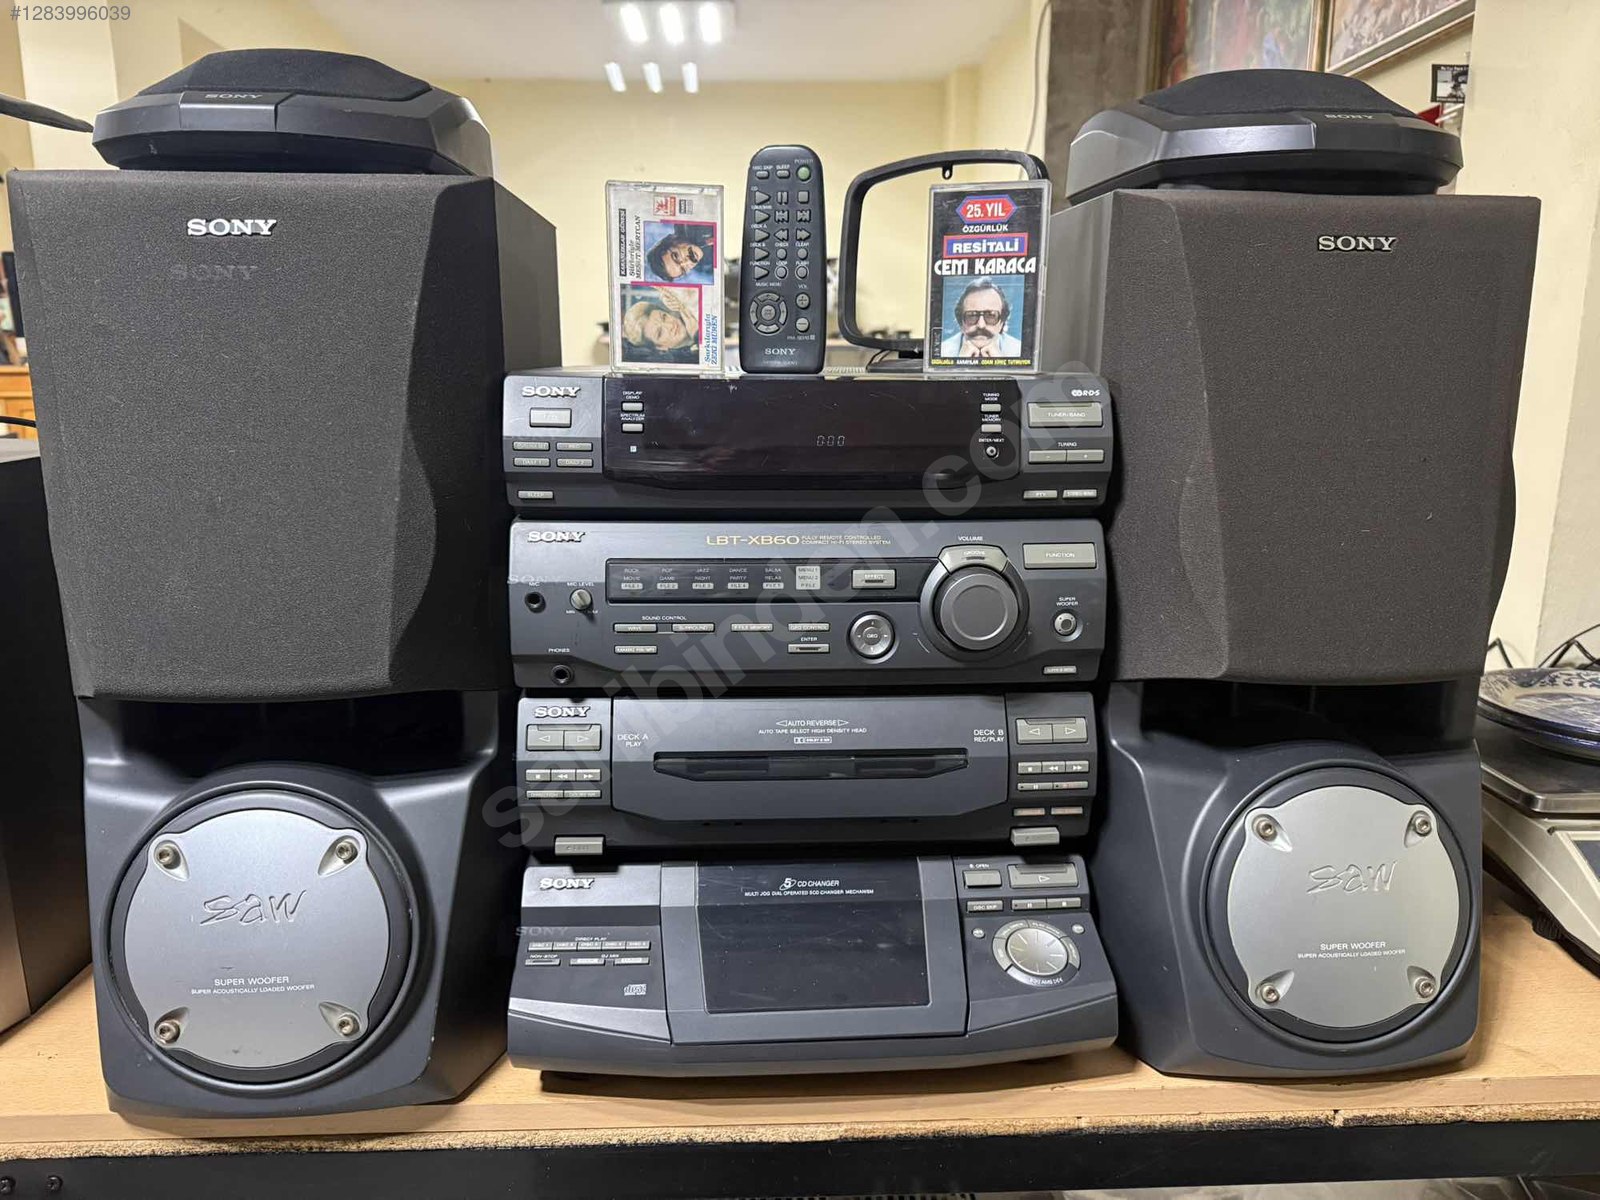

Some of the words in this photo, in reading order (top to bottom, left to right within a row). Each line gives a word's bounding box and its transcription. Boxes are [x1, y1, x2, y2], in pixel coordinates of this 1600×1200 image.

[966, 204, 984, 218] 25.
[986, 202, 1006, 218] YIL
[187, 218, 278, 236] SONY
[953, 238, 1018, 254] RESİTALİ
[1318, 235, 1397, 251] SONY
[934, 259, 968, 276] CEM
[974, 256, 1036, 275] KARACA
[522, 386, 581, 399] SONY
[528, 530, 586, 543] SONY
[706, 536, 800, 546] LBT-XB60
[534, 705, 591, 718] SONY
[540, 878, 595, 890] SONY
[1320, 943, 1348, 951] SUPER
[1350, 942, 1386, 950] WOOFER
[214, 978, 245, 986] SUPER
[248, 976, 290, 986] WOOFER
